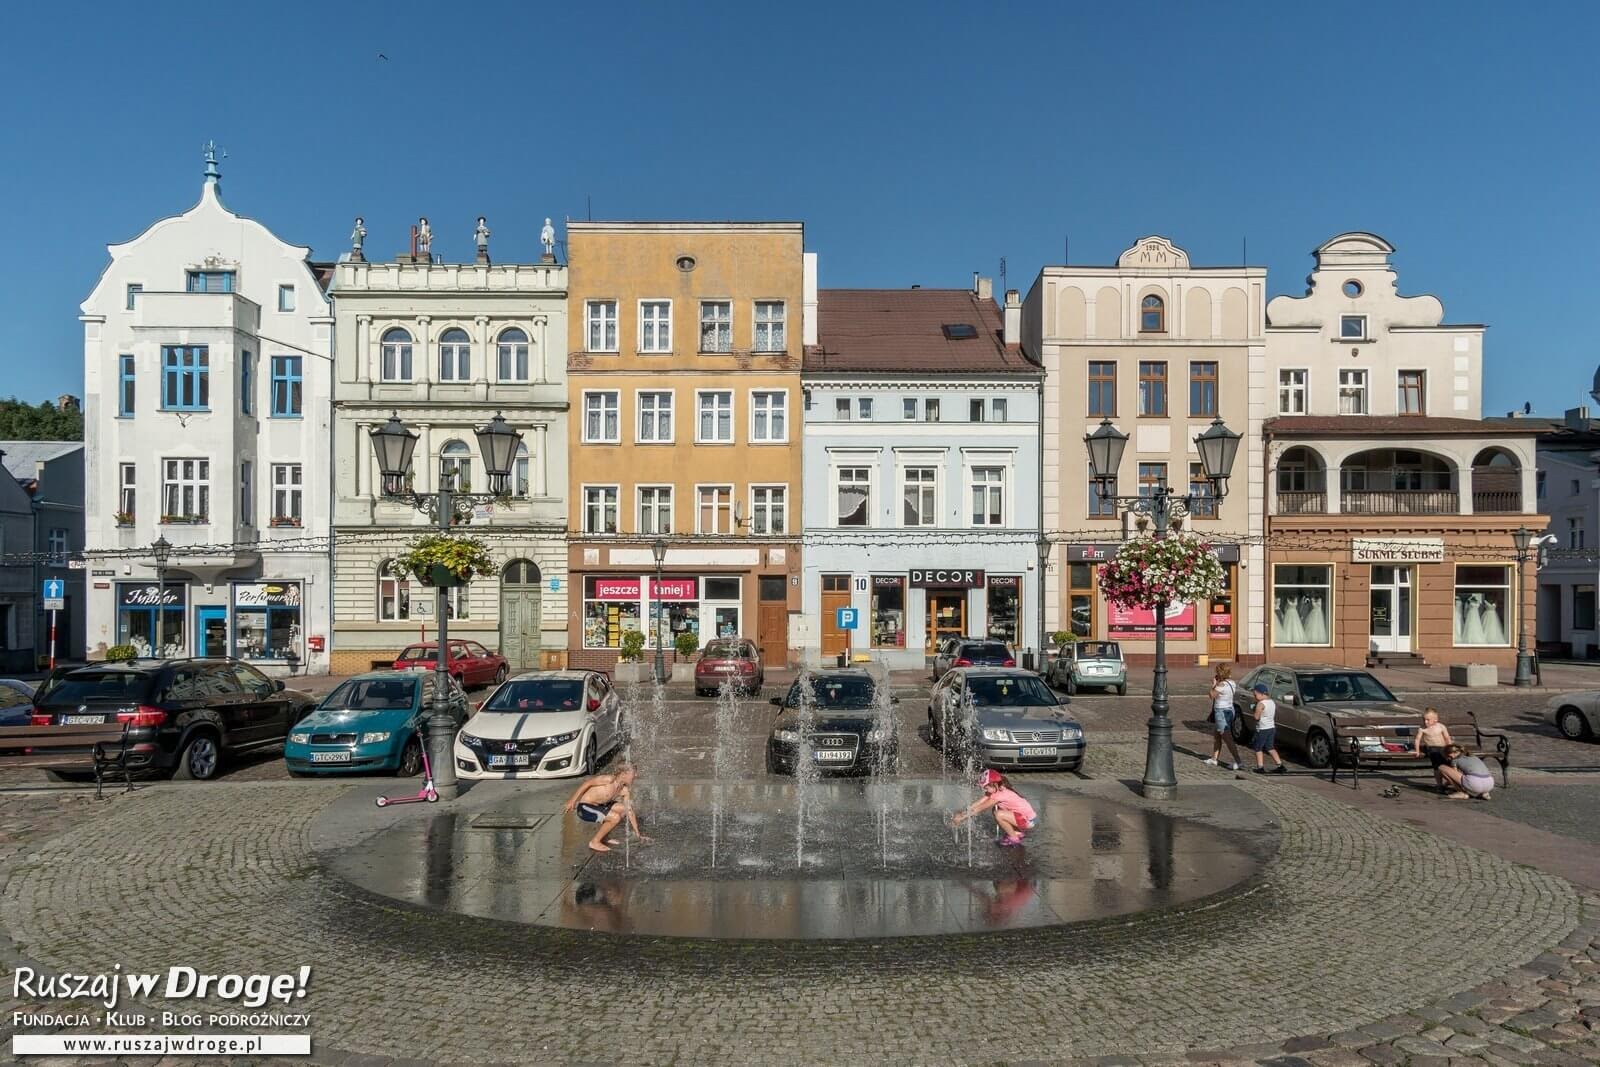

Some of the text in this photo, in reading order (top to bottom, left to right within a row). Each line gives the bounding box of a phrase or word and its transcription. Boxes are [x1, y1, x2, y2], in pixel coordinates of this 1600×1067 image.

[598, 584, 639, 597] jeszcze
[653, 584, 684, 597] taniej
[855, 578, 867, 591] 10
[841, 610, 854, 627] P
